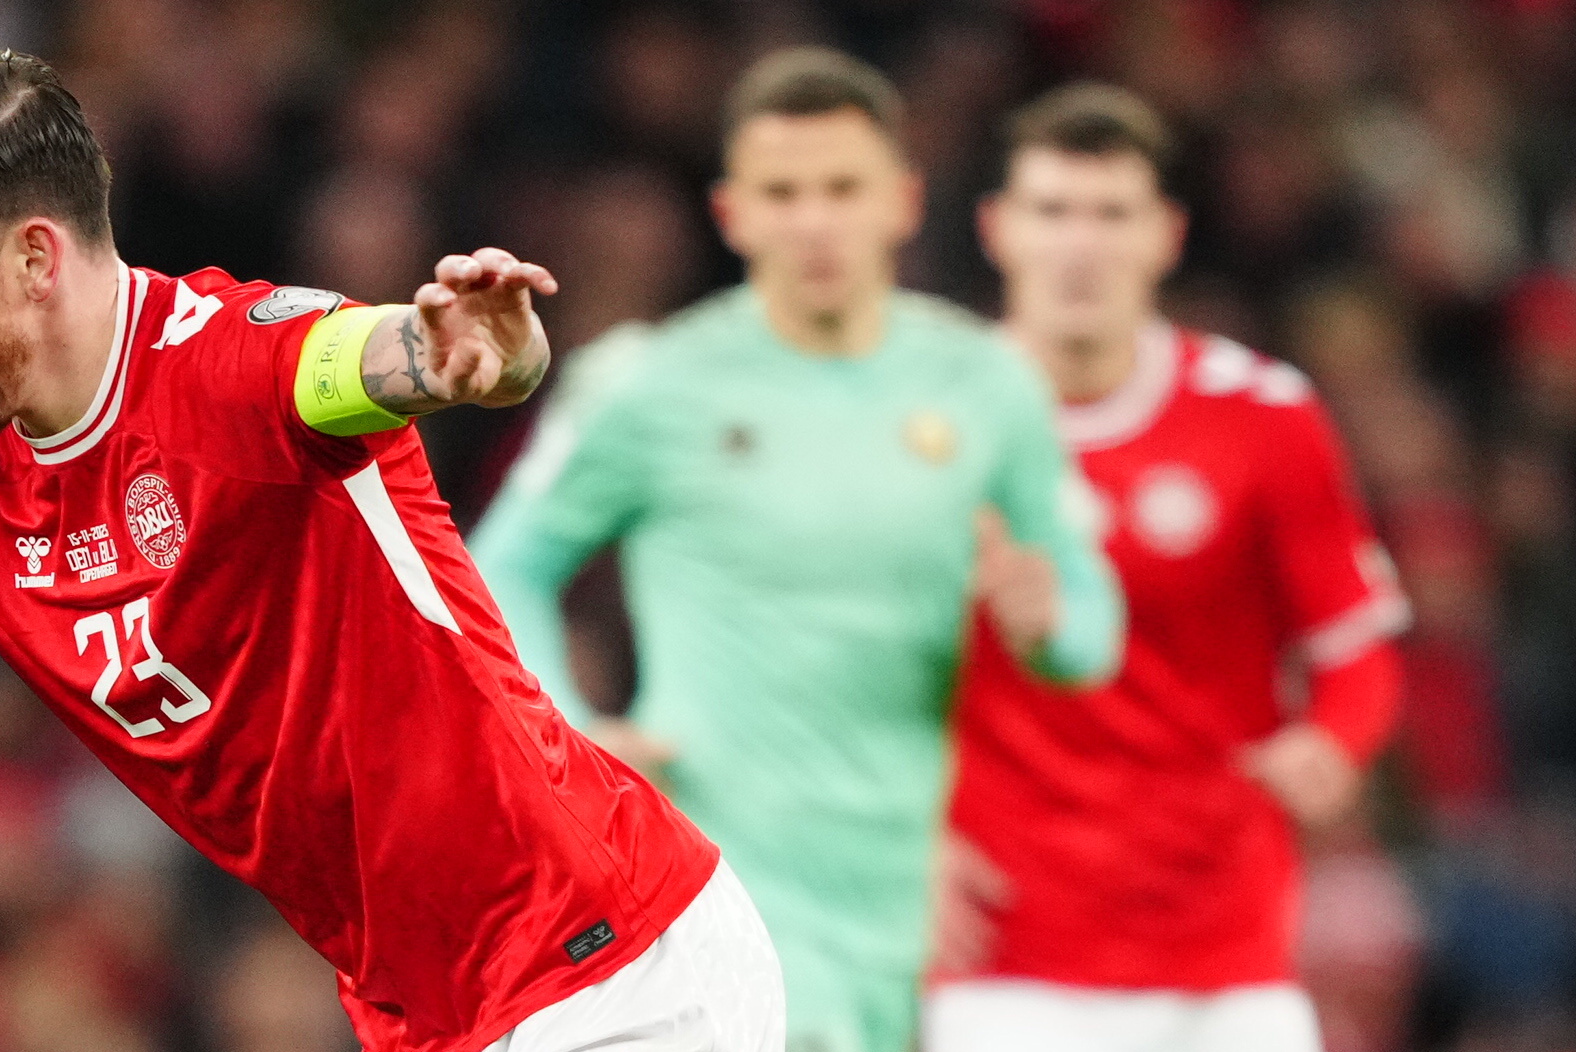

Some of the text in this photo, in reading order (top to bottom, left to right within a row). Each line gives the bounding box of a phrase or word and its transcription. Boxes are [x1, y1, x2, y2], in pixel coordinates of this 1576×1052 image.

[136, 501, 174, 540] DBU
[65, 546, 92, 571] DEN
[159, 546, 181, 566] 1889
[14, 572, 56, 589] hummel
[73, 597, 211, 738] 23
